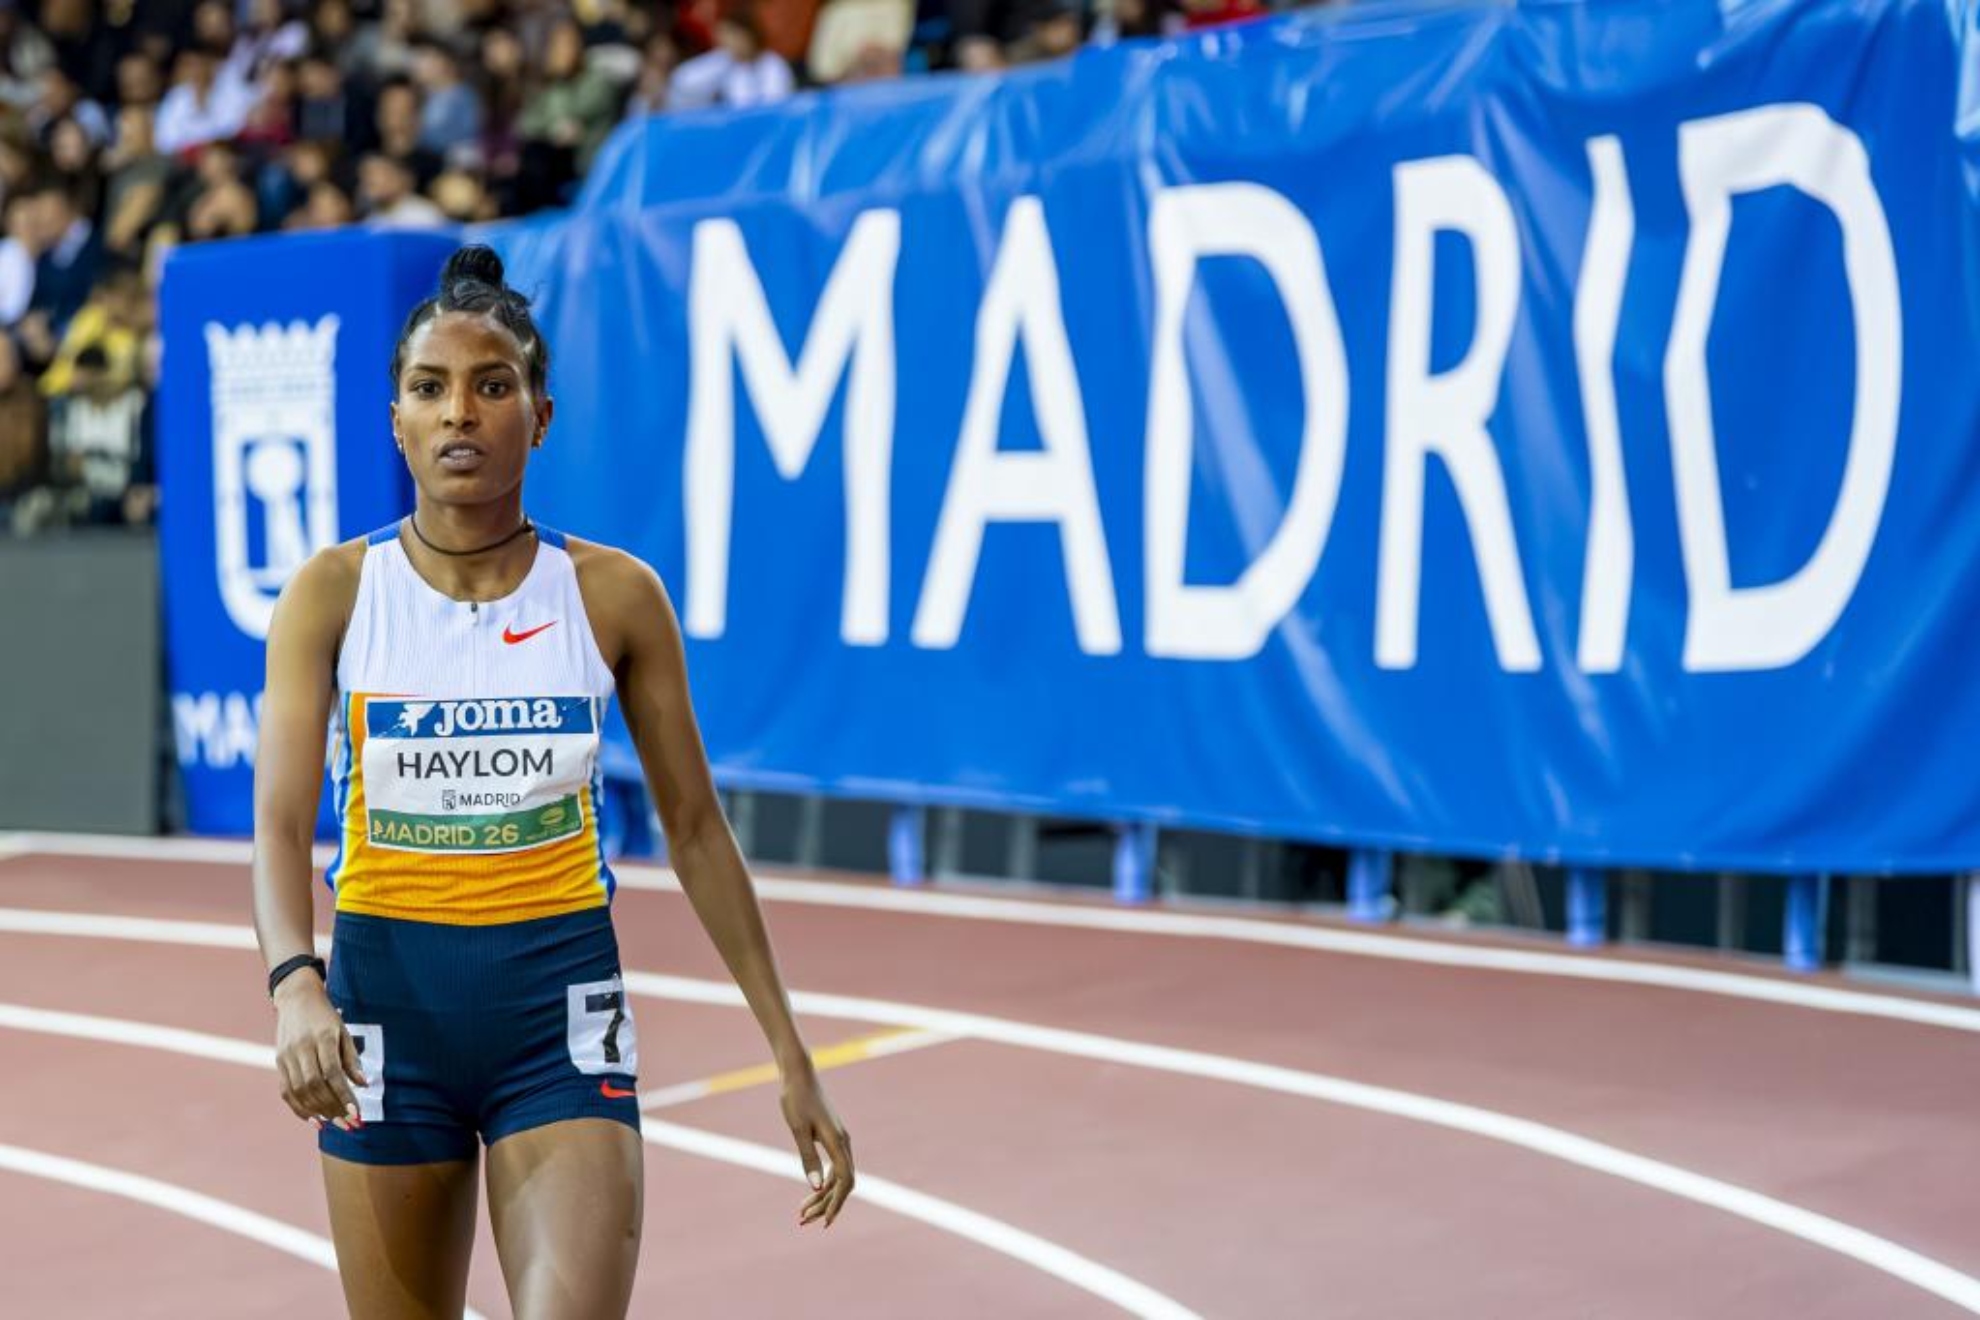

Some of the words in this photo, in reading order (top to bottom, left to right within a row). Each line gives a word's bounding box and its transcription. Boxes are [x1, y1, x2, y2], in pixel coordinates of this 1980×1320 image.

[683, 102, 1903, 673] MADRID
[173, 690, 264, 768] MA
[396, 748, 554, 779] HAYLOM
[459, 792, 521, 808] MADRID
[372, 819, 476, 846] MADRID
[483, 823, 520, 846] 26
[585, 990, 625, 1064] 7
